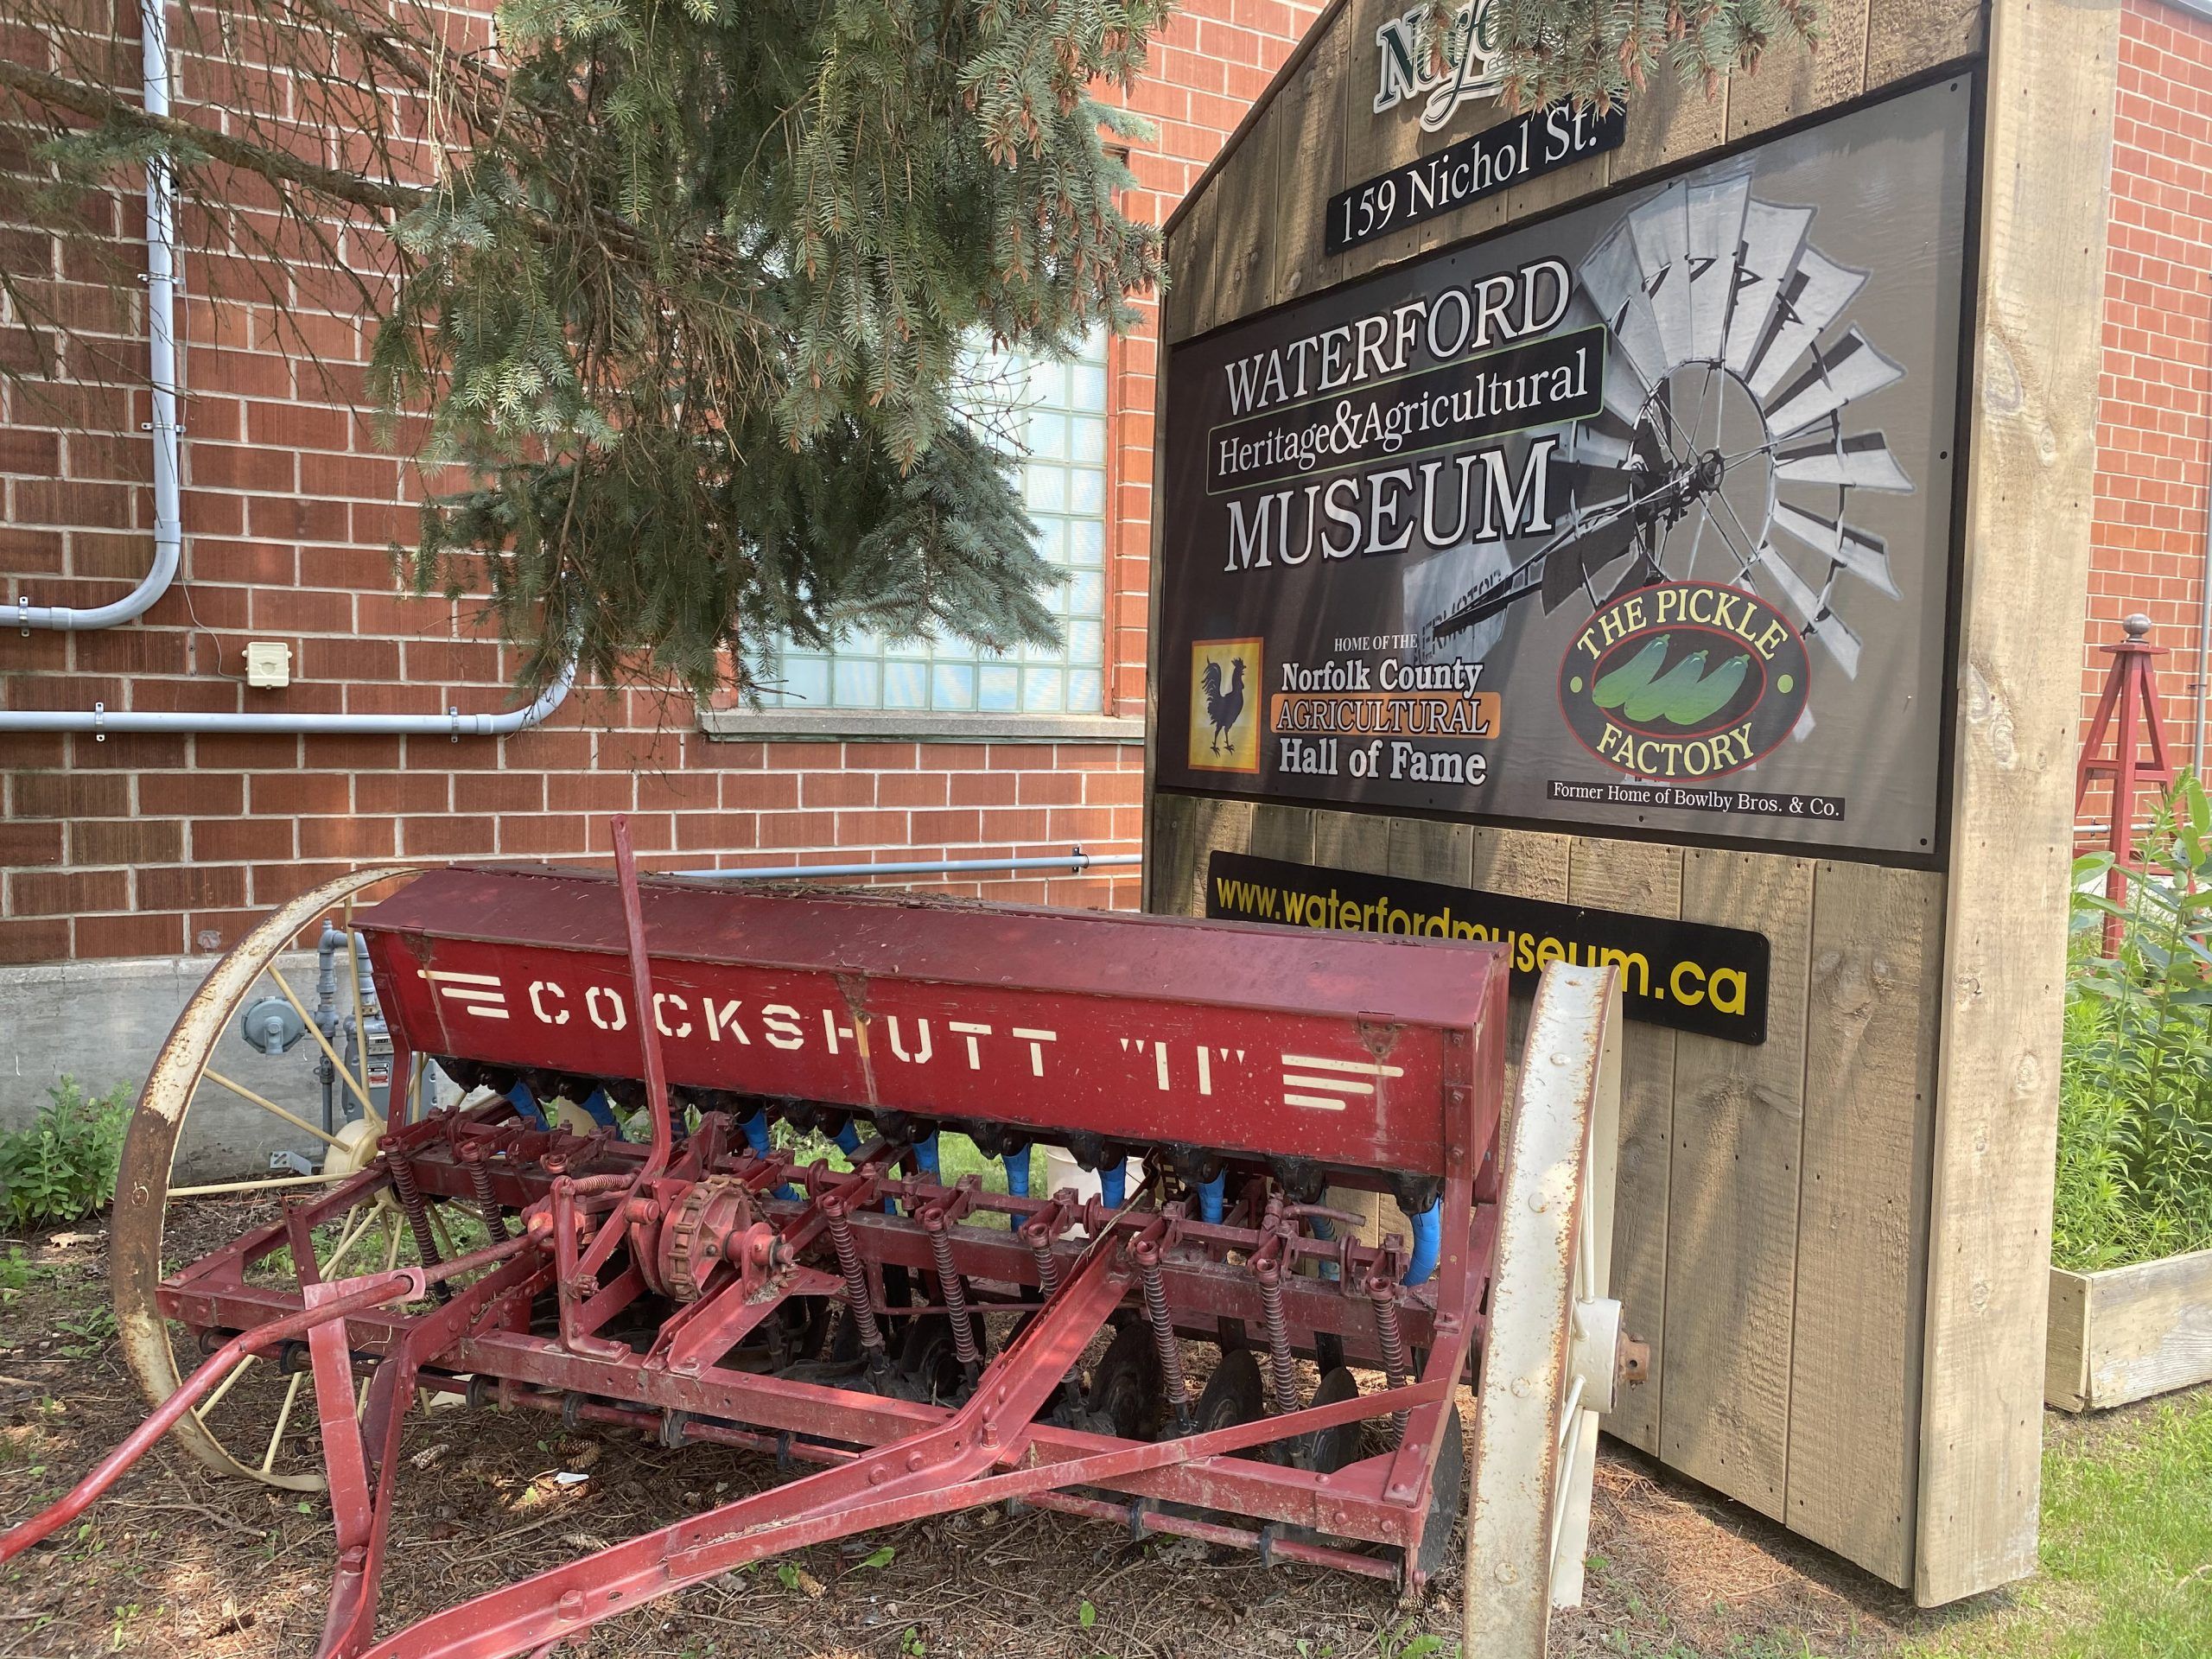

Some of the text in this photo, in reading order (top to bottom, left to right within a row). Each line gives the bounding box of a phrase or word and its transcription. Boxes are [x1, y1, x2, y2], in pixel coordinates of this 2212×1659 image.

[1341, 103, 1598, 243] 159 Nichol St.
[1224, 259, 1571, 416] WATERFORD
[1224, 439, 1556, 572] MUSEUM
[1333, 633, 1419, 653] HOME OF THE
[1577, 588, 1789, 660] THE PICKLE
[1281, 657, 1484, 699] Norfolk County
[1276, 699, 1491, 735] AGRICULTURAL
[1279, 737, 1487, 785] Hall of Fame
[1596, 722, 1754, 776] FACTORY
[1553, 781, 1840, 817] Former Home of Bowlby Bros. & Co.
[528, 981, 1057, 1077] COCKSHUTT
